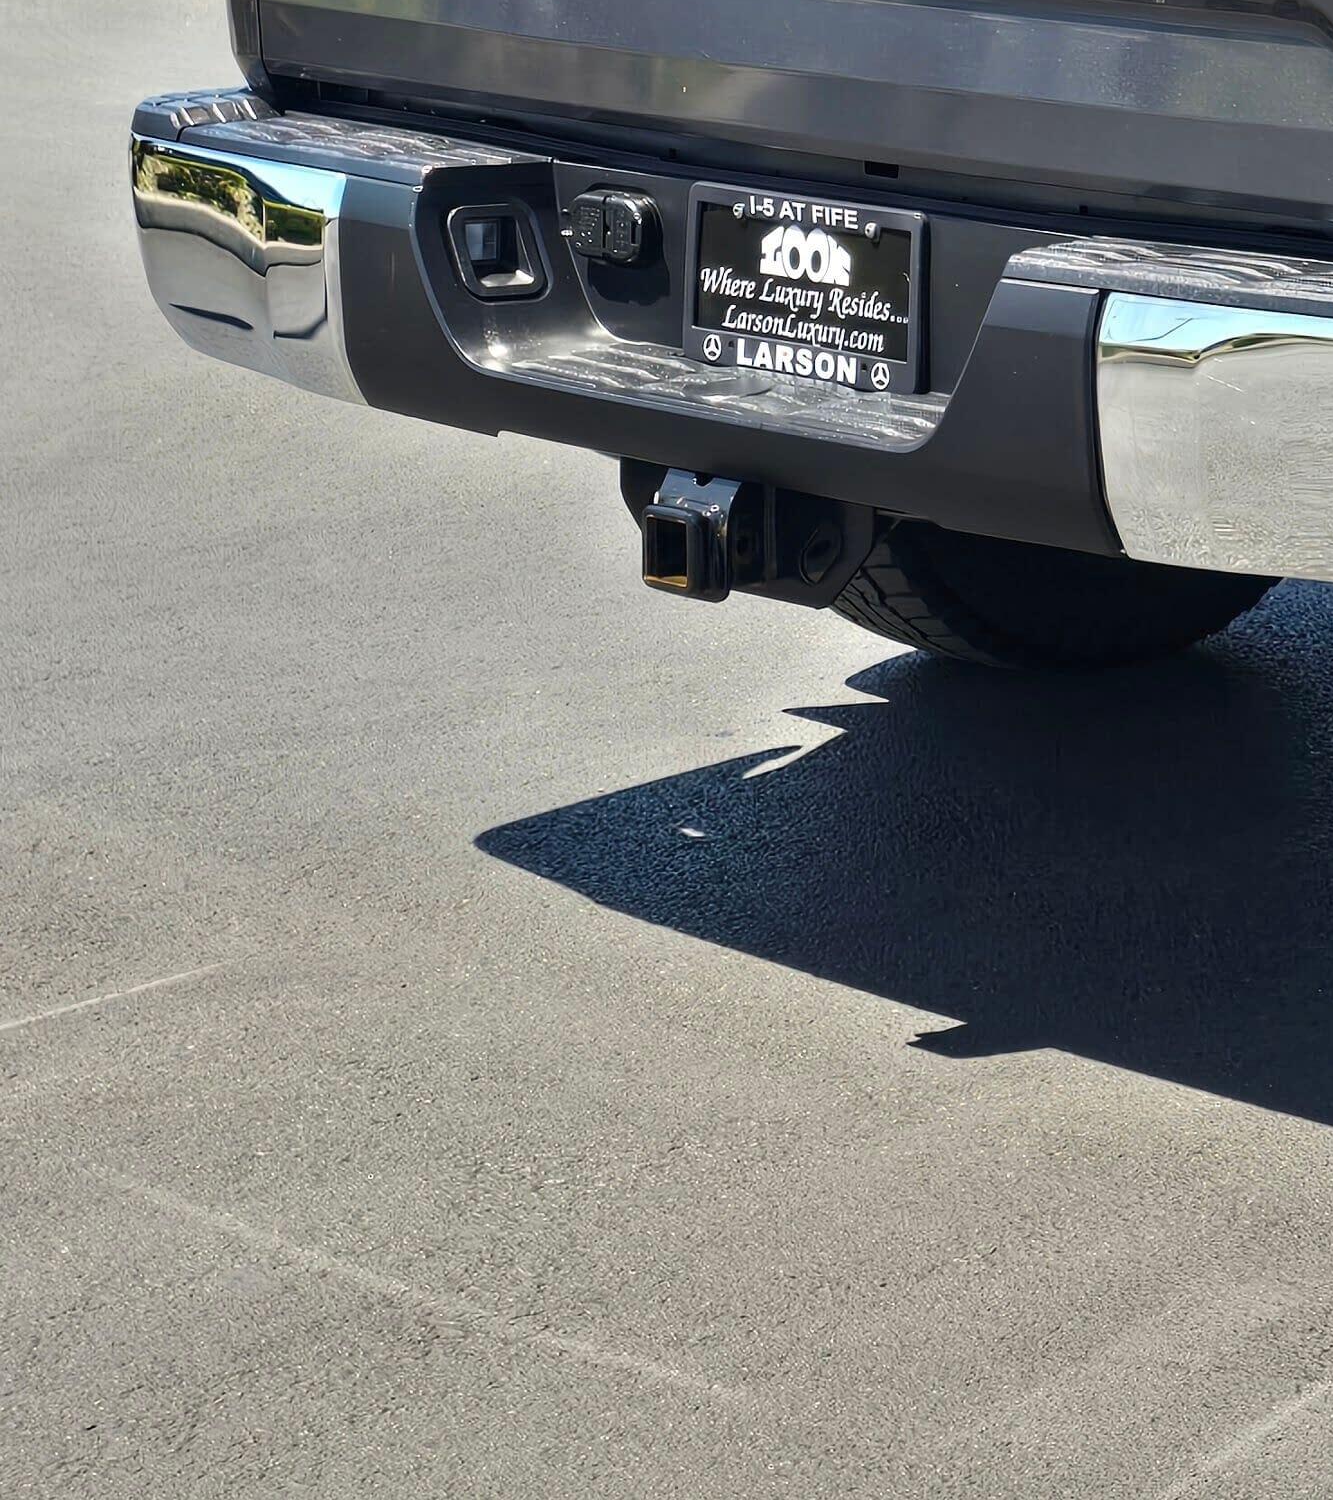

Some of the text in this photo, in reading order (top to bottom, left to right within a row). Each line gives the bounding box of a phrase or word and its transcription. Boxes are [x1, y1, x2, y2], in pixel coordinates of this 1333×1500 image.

[750, 195, 859, 231] I-5 AT FIFE
[700, 266, 756, 300] Where
[759, 277, 823, 318] Luxury
[721, 304, 885, 353] LarsonLuxury.com
[736, 338, 857, 385] LARSON
